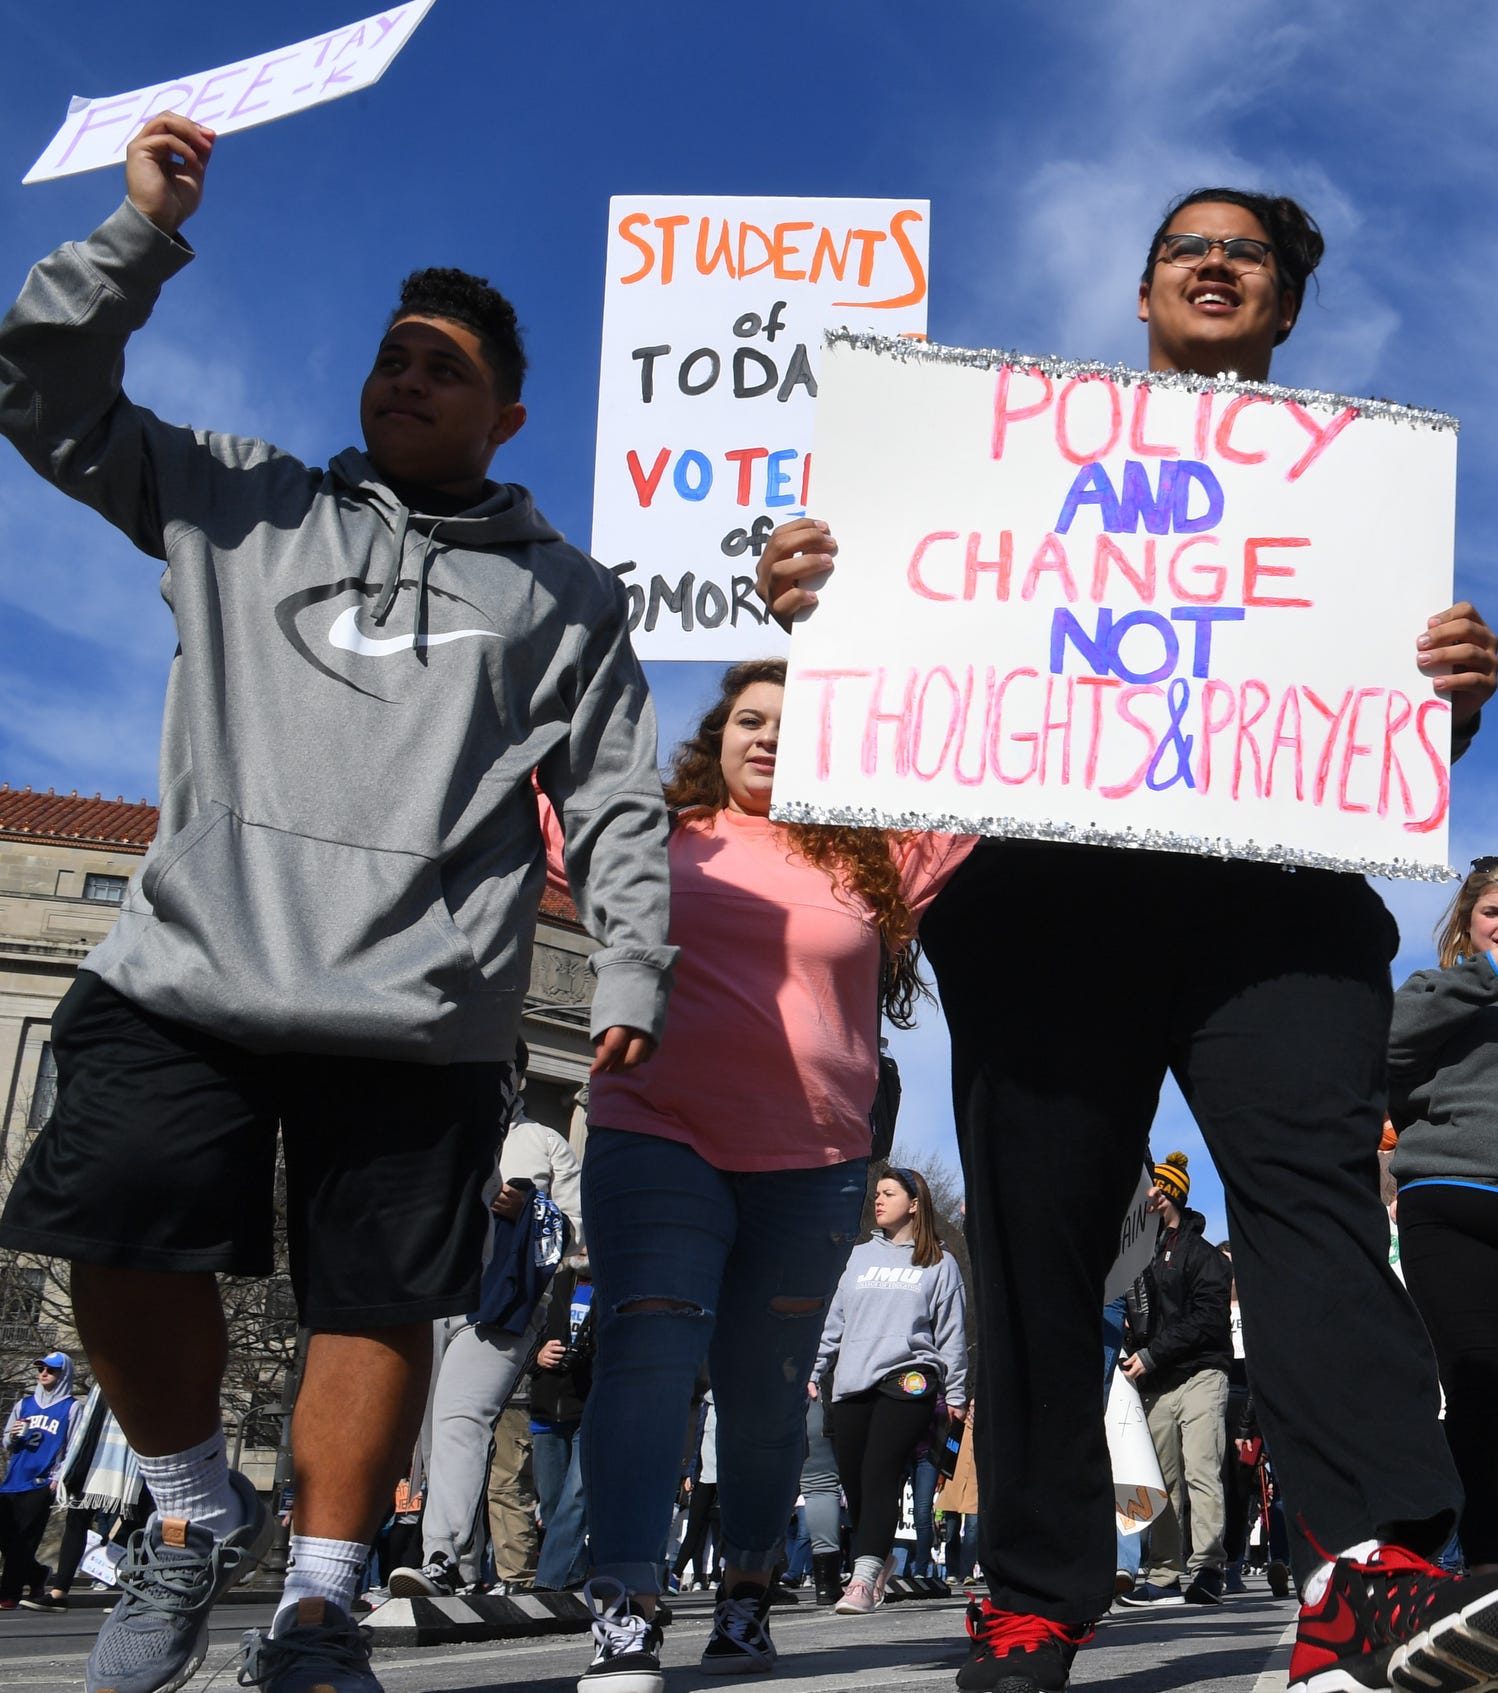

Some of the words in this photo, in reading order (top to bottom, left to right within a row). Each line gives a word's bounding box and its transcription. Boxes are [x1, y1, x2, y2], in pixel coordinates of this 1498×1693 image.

[618, 209, 927, 309] STUDENTS
[733, 300, 787, 342] of
[631, 343, 817, 403] TODA
[990, 364, 1362, 482] POLICY
[625, 446, 813, 508] VOTE
[1053, 459, 1225, 535] AND
[906, 529, 1315, 608] CHANGE
[1049, 606, 1246, 685] NOT
[857, 1266, 924, 1284] JMU
